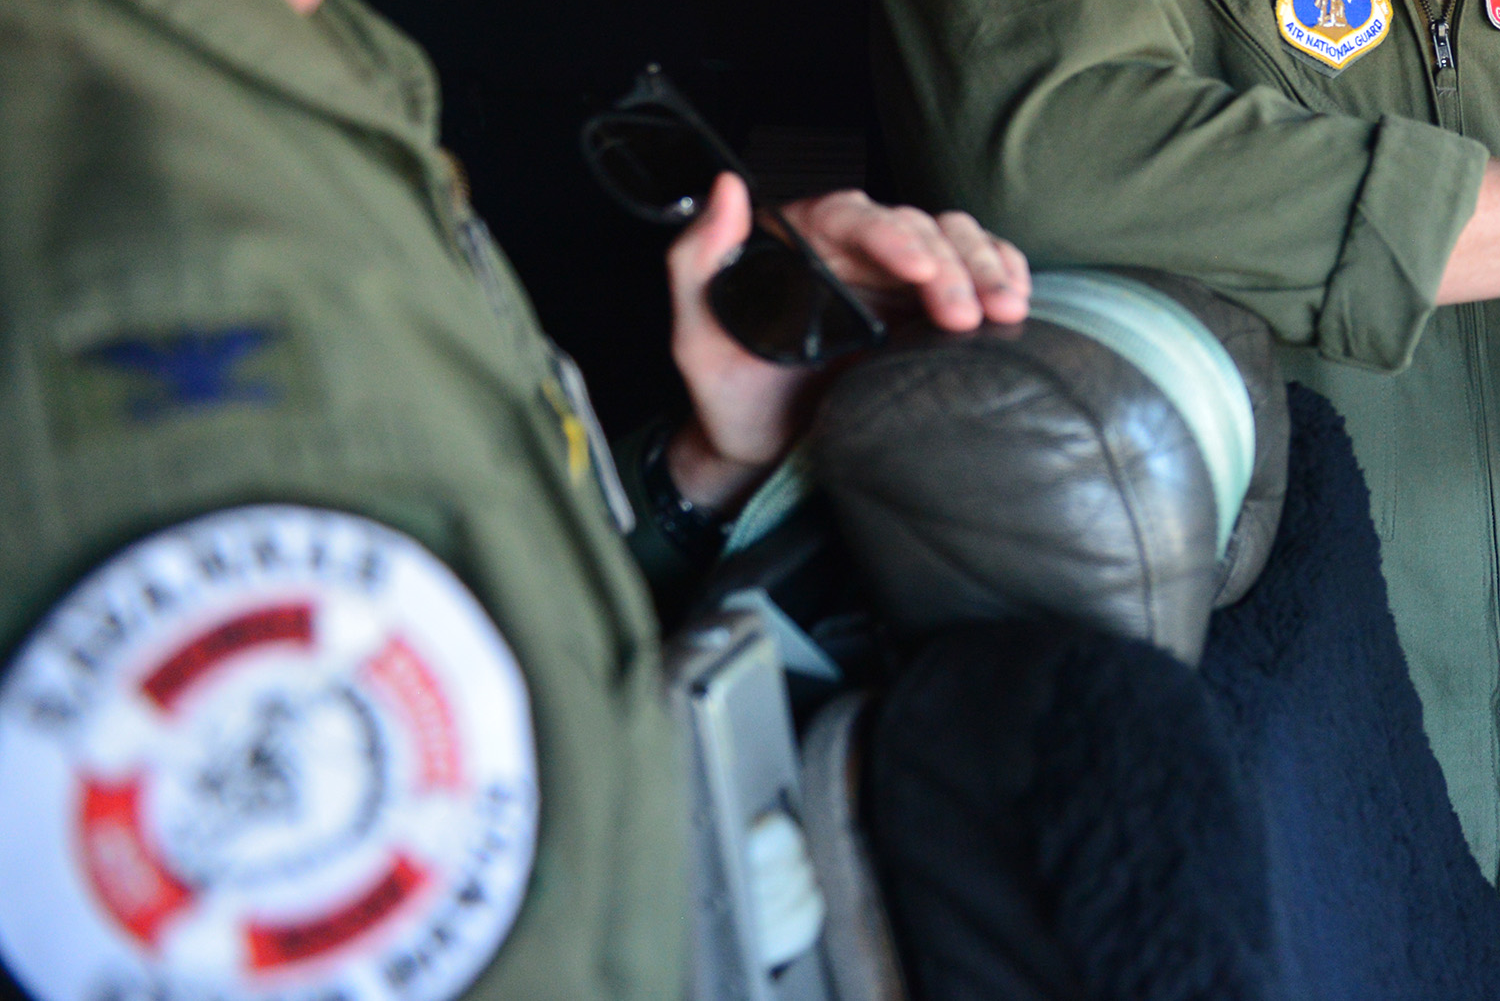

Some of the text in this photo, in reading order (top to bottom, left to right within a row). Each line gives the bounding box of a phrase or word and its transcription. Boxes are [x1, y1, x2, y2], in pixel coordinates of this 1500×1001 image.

[1285, 18, 1383, 60] AIR NATIONAL GUARD
